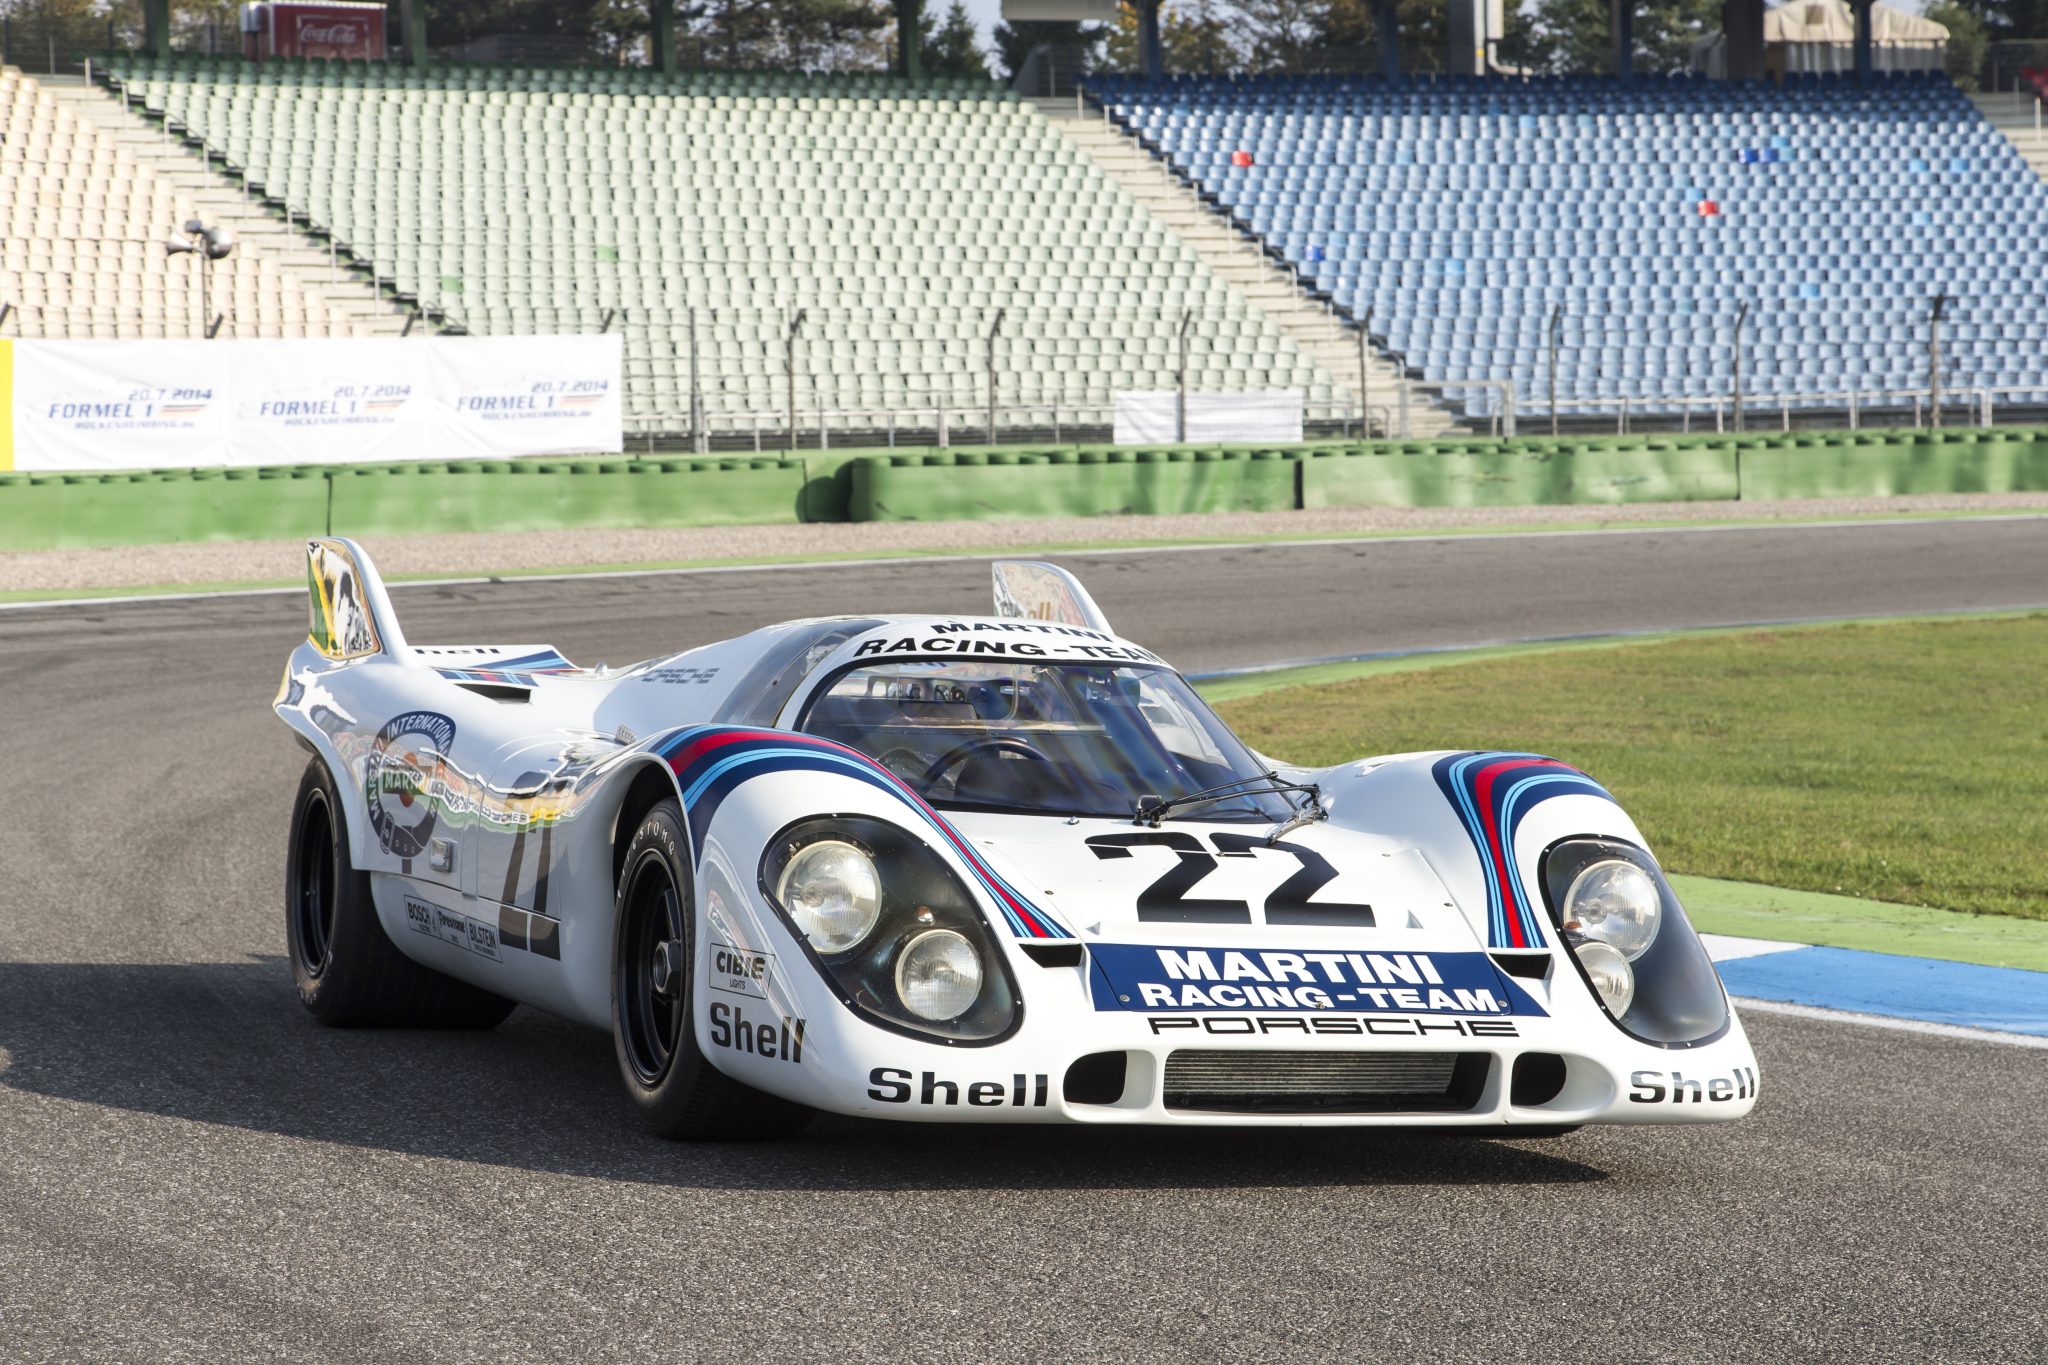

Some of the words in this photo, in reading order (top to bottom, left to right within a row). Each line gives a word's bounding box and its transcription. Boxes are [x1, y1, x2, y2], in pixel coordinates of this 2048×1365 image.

[48, 403, 134, 418] FORMEL
[260, 400, 340, 416] FORMEL
[456, 395, 538, 411] FORMEL
[930, 621, 1115, 643] MARTINI
[414, 647, 501, 655] hell
[634, 667, 721, 684] ORSCHE
[1084, 831, 1377, 928] 22
[407, 902, 431, 926] BOSCH
[437, 911, 466, 934] Firestone
[469, 923, 497, 950] BILSTEIN
[1155, 949, 1444, 985] MARTINI
[710, 1001, 807, 1064] Shell
[1147, 1018, 1521, 1038] PORSCHE
[867, 1067, 1048, 1107] Shell
[1629, 1066, 1755, 1104] Shell
